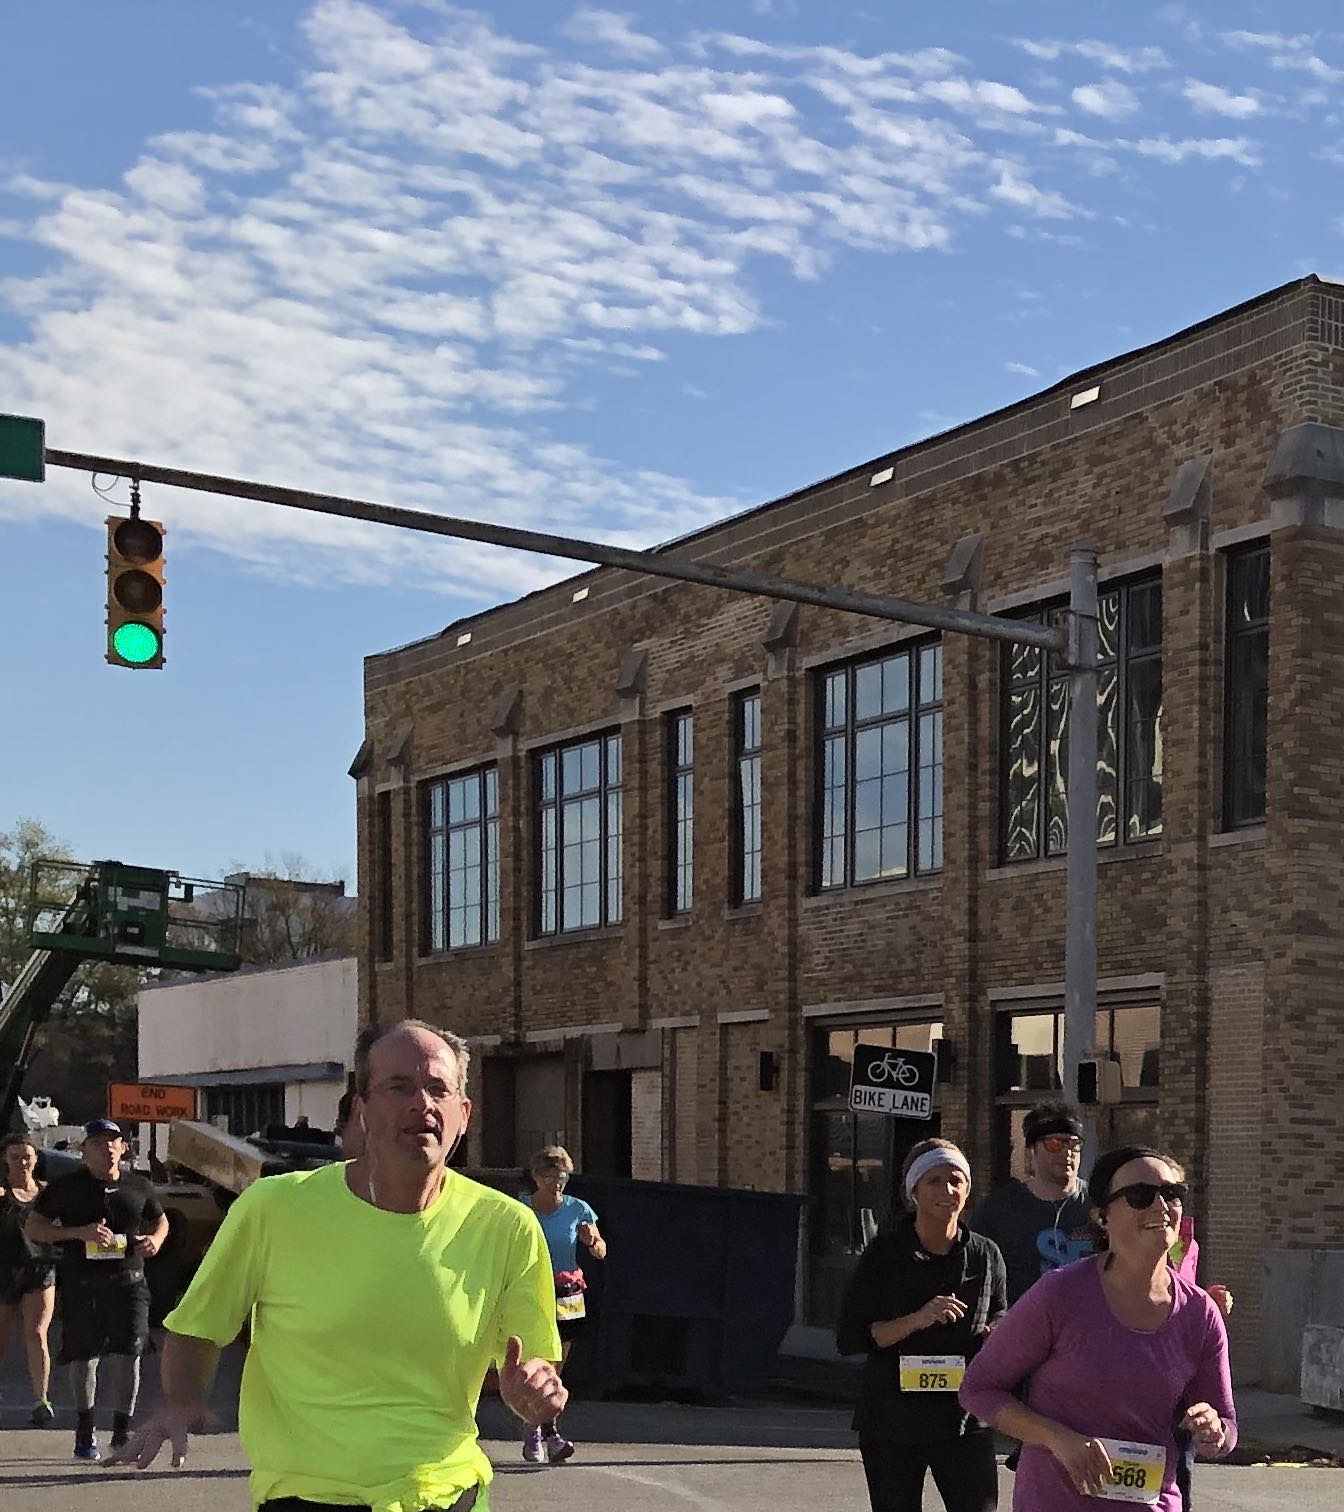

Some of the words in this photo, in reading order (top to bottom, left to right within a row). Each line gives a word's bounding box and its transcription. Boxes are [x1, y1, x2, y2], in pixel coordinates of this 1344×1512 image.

[140, 1086, 167, 1100] END
[854, 1089, 886, 1108] BIKE
[892, 1093, 928, 1113] LANE
[120, 1103, 150, 1116] ROAD
[156, 1104, 188, 1118] WORK
[920, 1373, 948, 1388] 875
[1112, 1465, 1147, 1489] 568
